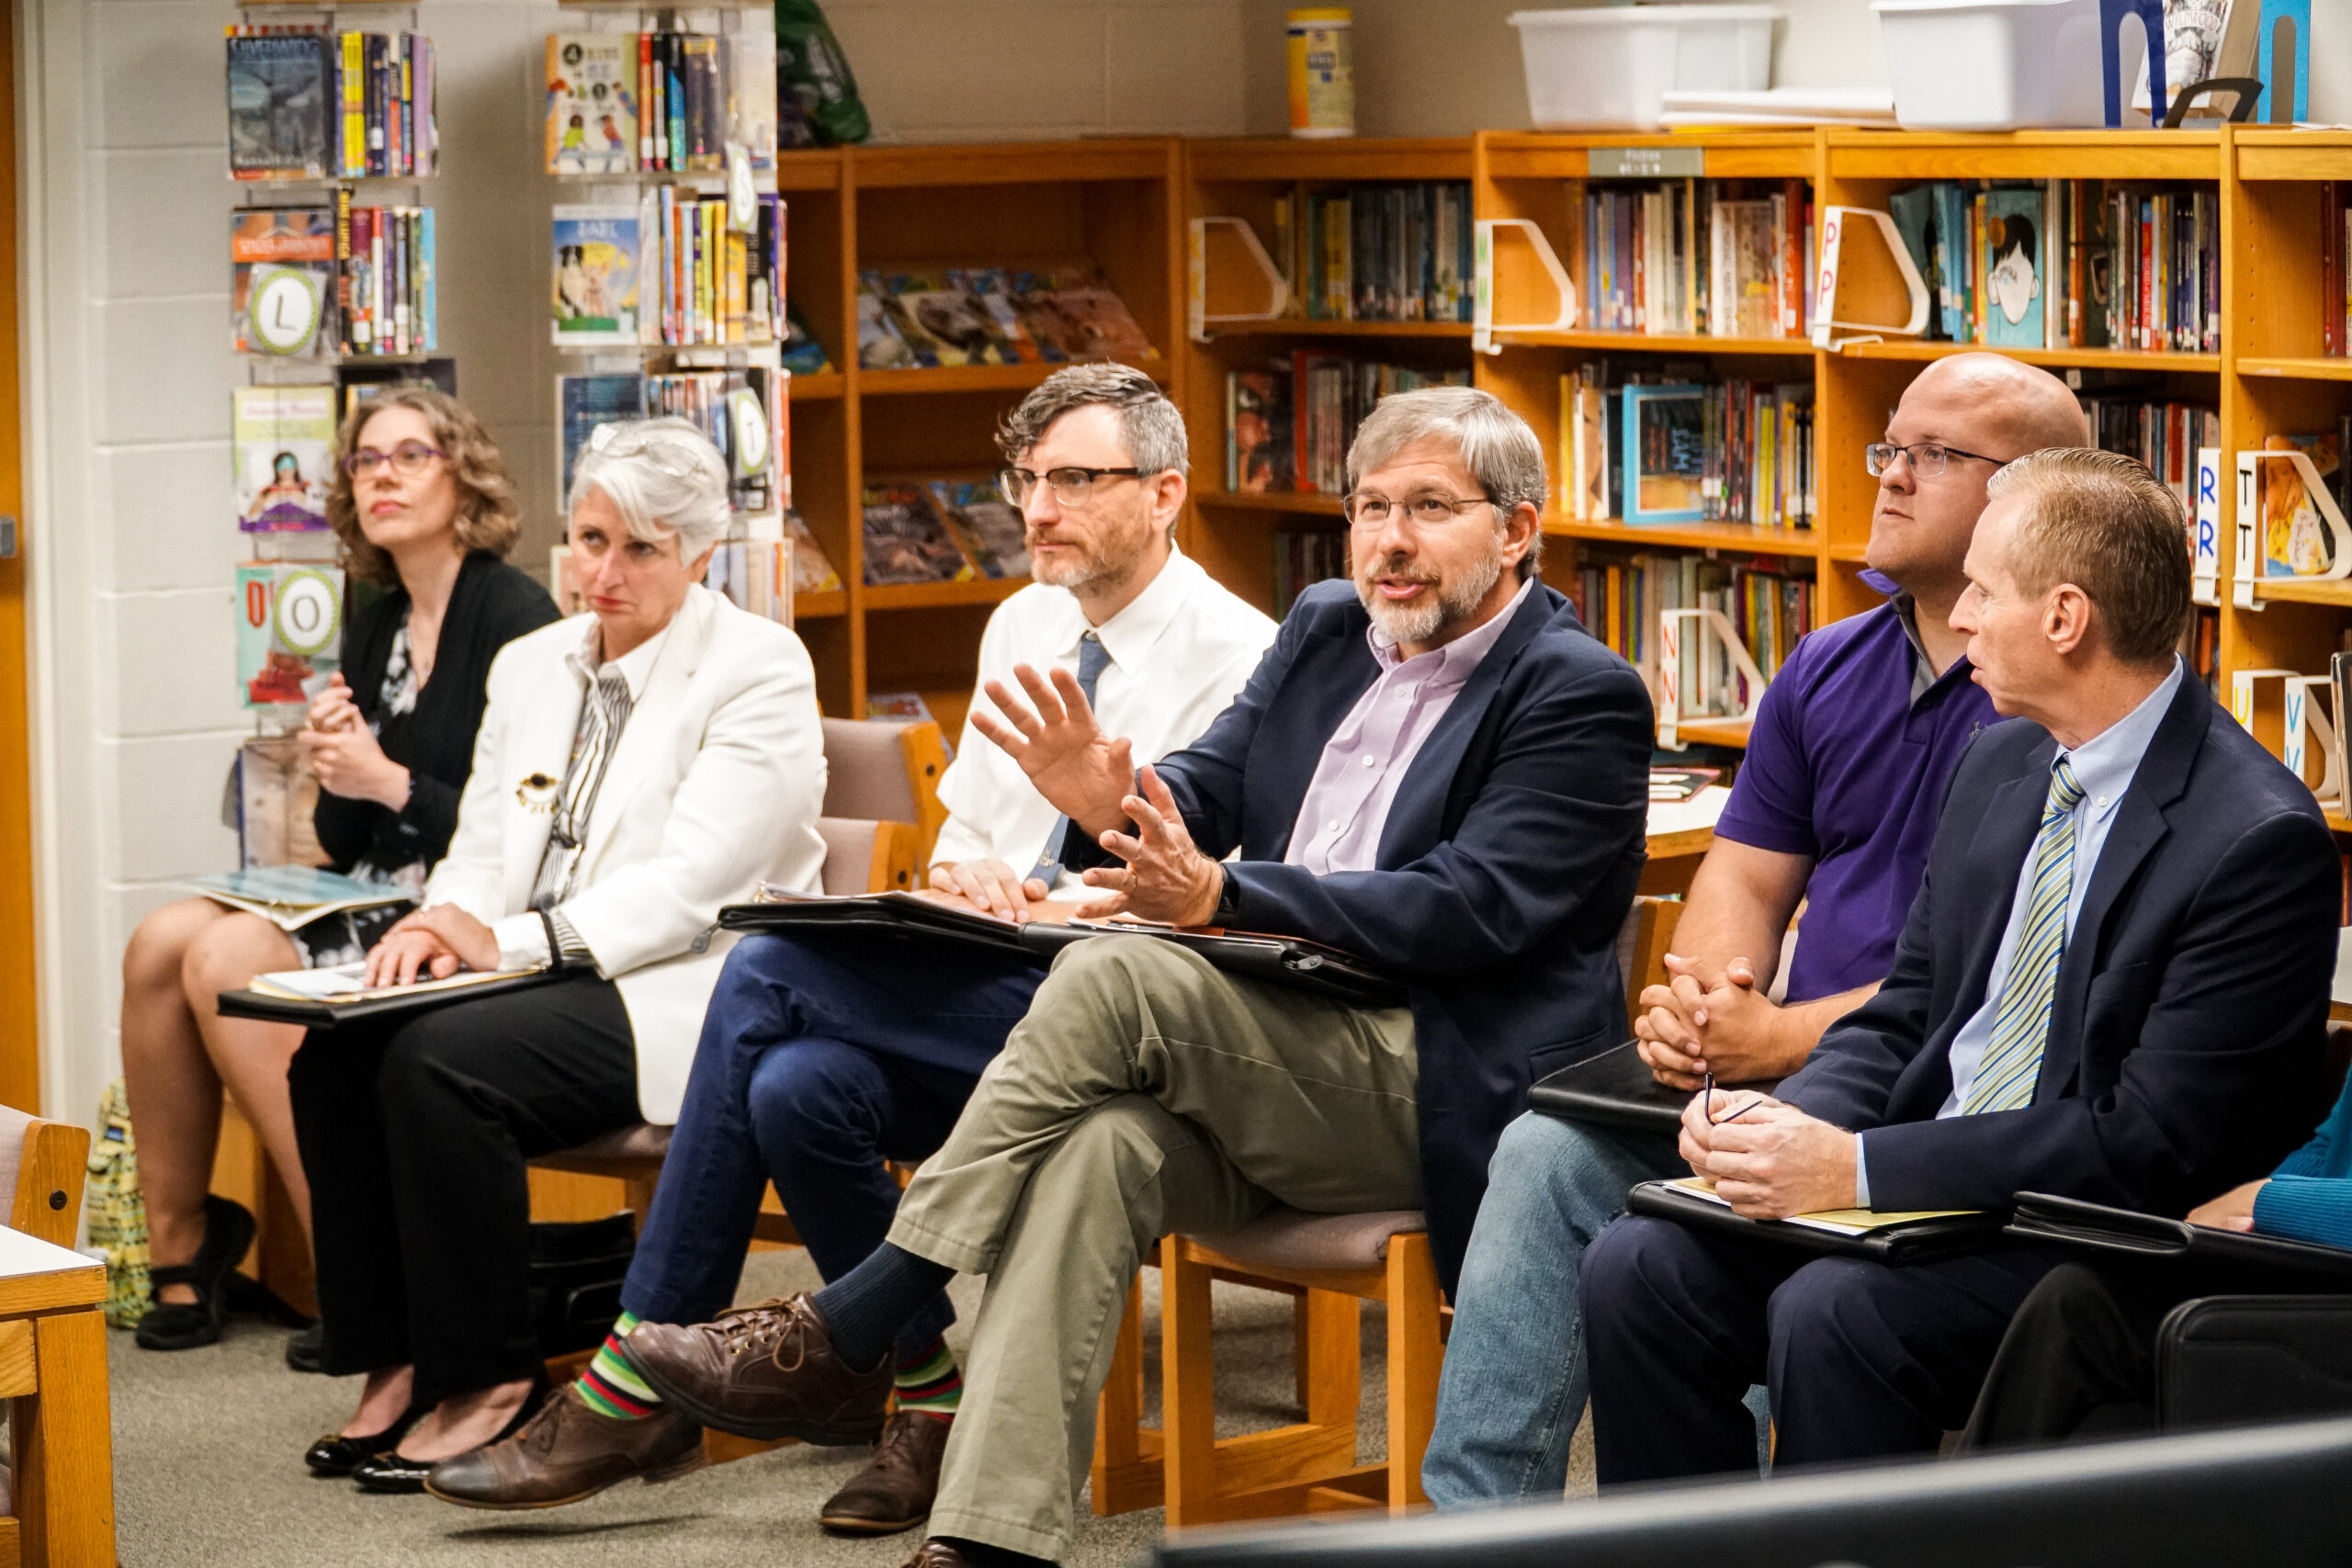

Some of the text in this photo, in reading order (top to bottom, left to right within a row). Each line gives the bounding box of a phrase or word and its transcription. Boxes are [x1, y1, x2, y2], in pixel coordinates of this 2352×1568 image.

[1823, 220, 1837, 258] P
[1819, 270, 1833, 305] P
[276, 293, 297, 332] L
[2200, 466, 2216, 504] R
[2239, 468, 2252, 506] T
[2199, 519, 2214, 558] R
[2238, 523, 2252, 561] T
[291, 594, 321, 633] O
[1663, 625, 1677, 660] N
[1663, 671, 1676, 705] N
[2234, 687, 2250, 726] U
[2287, 693, 2301, 733] V
